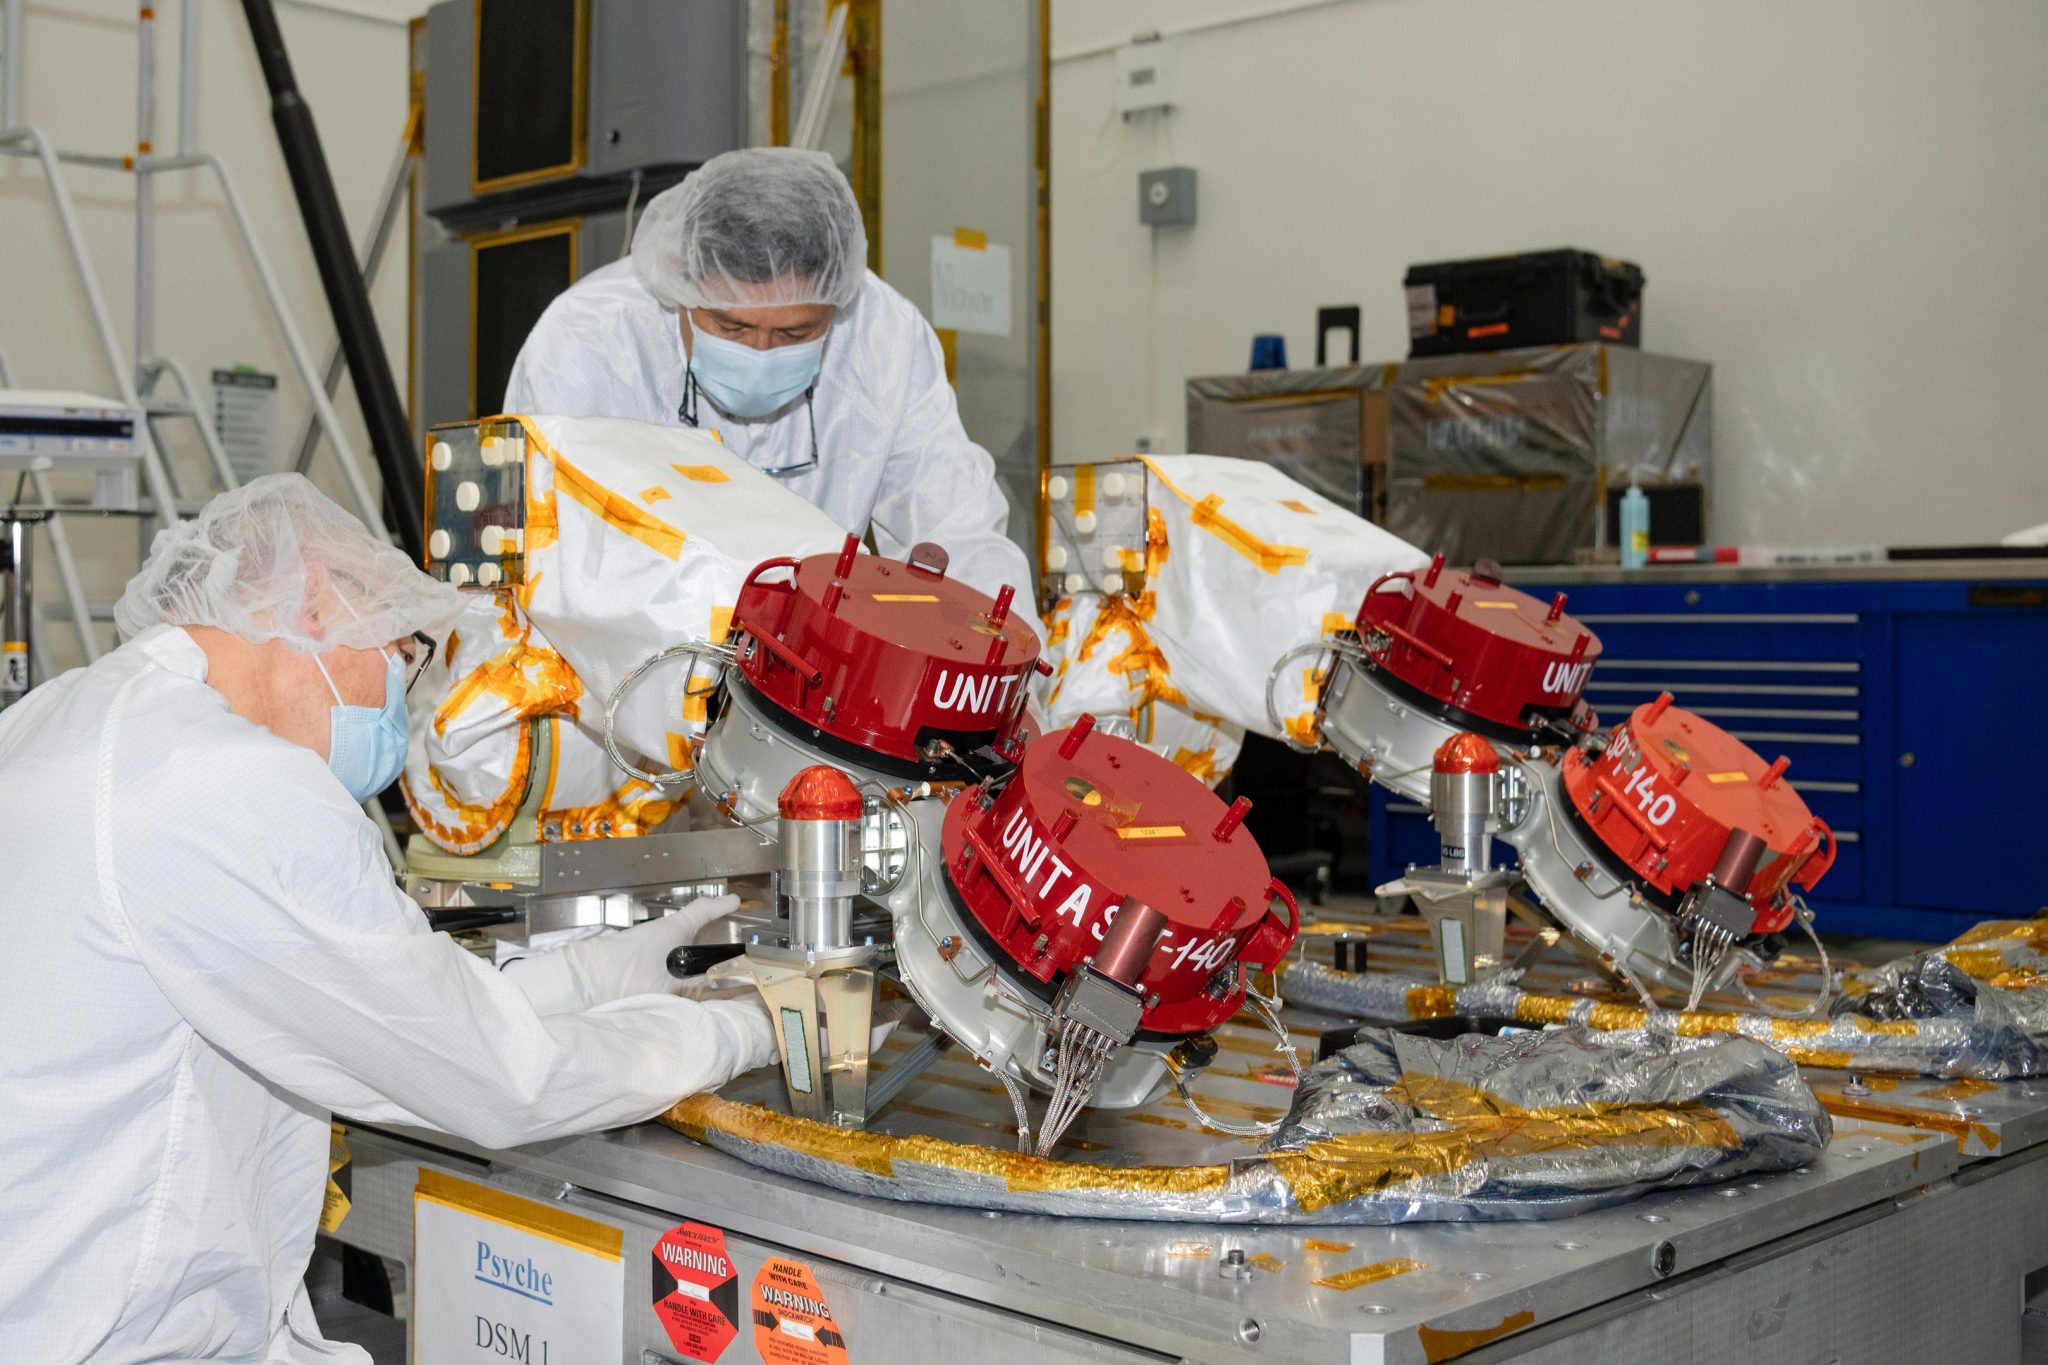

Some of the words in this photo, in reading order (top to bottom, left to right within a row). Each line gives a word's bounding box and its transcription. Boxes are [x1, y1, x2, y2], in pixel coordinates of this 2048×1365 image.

[934, 669, 1018, 714] UNIT
[1543, 661, 1592, 695] UNIT
[1003, 806, 1073, 900] UNIT
[1056, 884, 1092, 927] A
[475, 1240, 553, 1296] Psyche
[661, 1241, 728, 1278] WARNING
[773, 1262, 802, 1278] HANDLE
[768, 1272, 788, 1284] WITH
[787, 1277, 808, 1289] CARE
[664, 1299, 689, 1316] HANDLE
[689, 1307, 708, 1321] WITH
[708, 1313, 726, 1327] CARE
[759, 1282, 832, 1321] WARNING
[475, 1315, 531, 1365] DSM
[542, 1341, 549, 1365] 1
